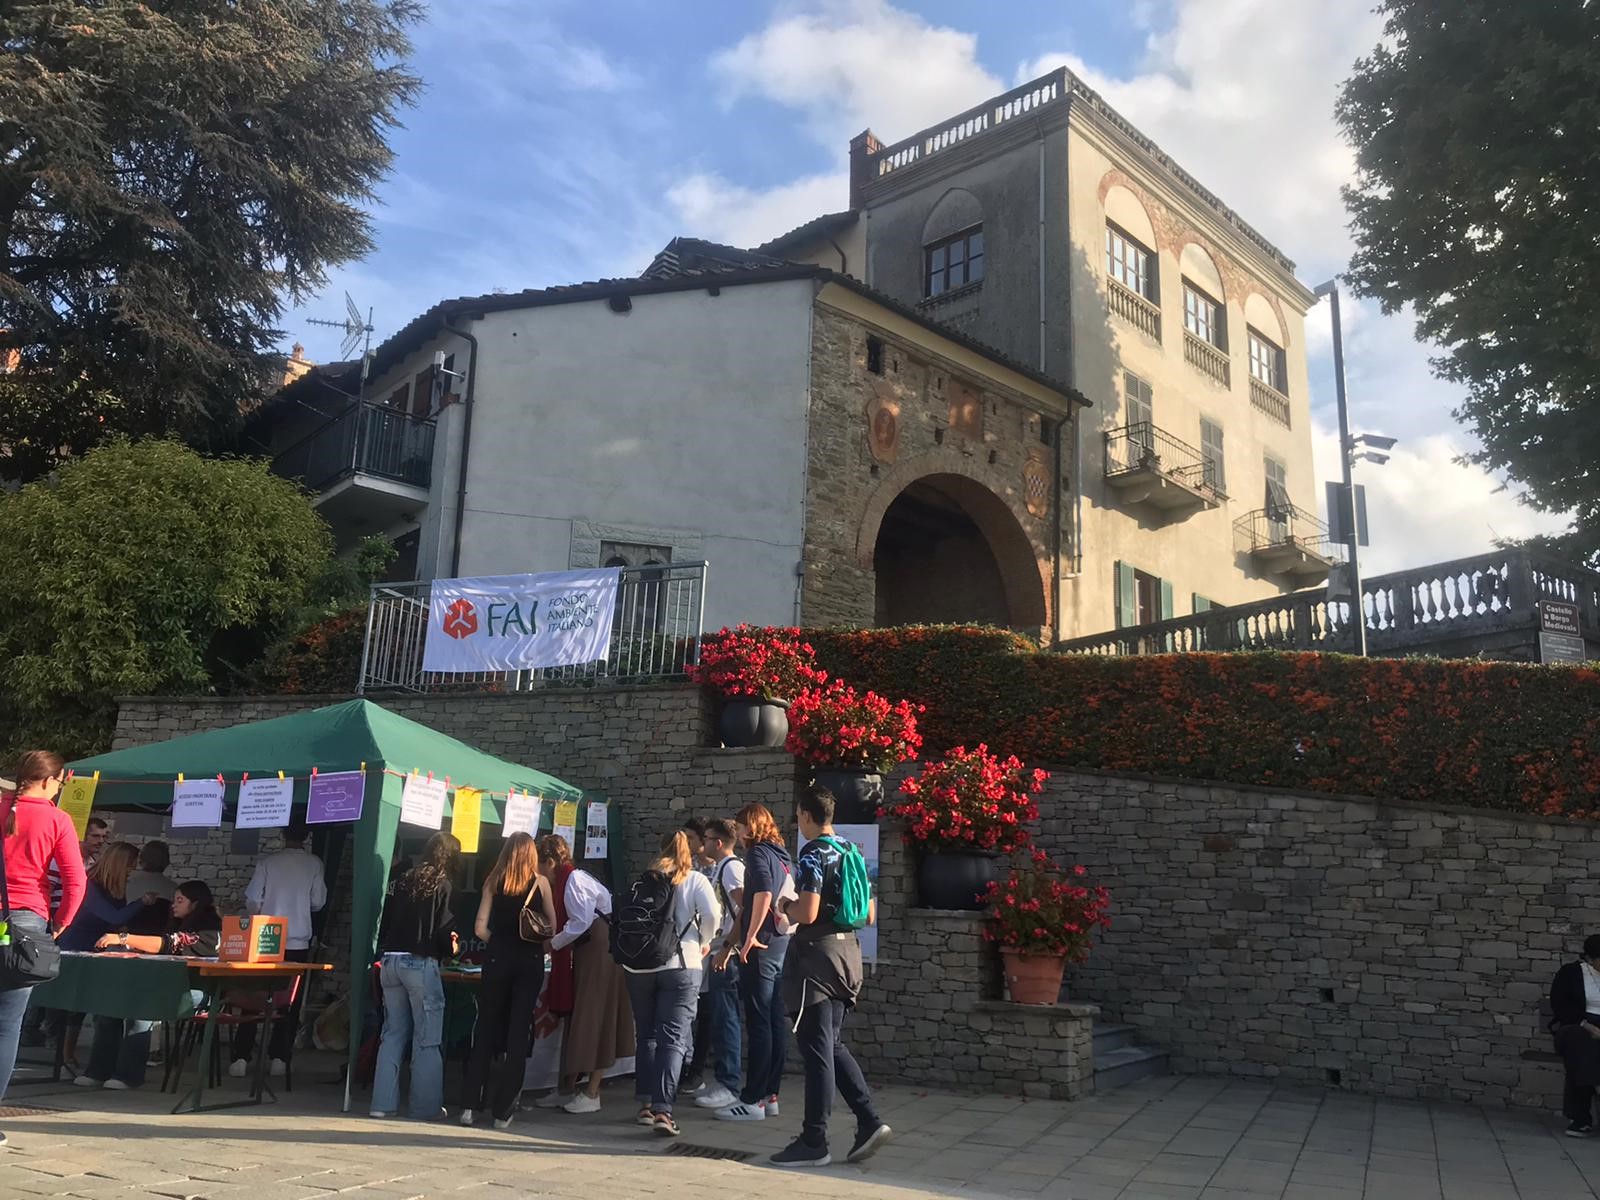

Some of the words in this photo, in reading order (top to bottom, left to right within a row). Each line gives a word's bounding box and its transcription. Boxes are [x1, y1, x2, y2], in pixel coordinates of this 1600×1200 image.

[548, 592, 588, 607] FONDO
[546, 604, 600, 621] AMBIENTE
[1546, 605, 1573, 615] Castello
[487, 600, 539, 637] FAI
[1550, 613, 1569, 623] Borgo
[547, 617, 594, 632] ITALIANO
[1545, 621, 1576, 631] Medievale
[259, 925, 273, 935] FAI
